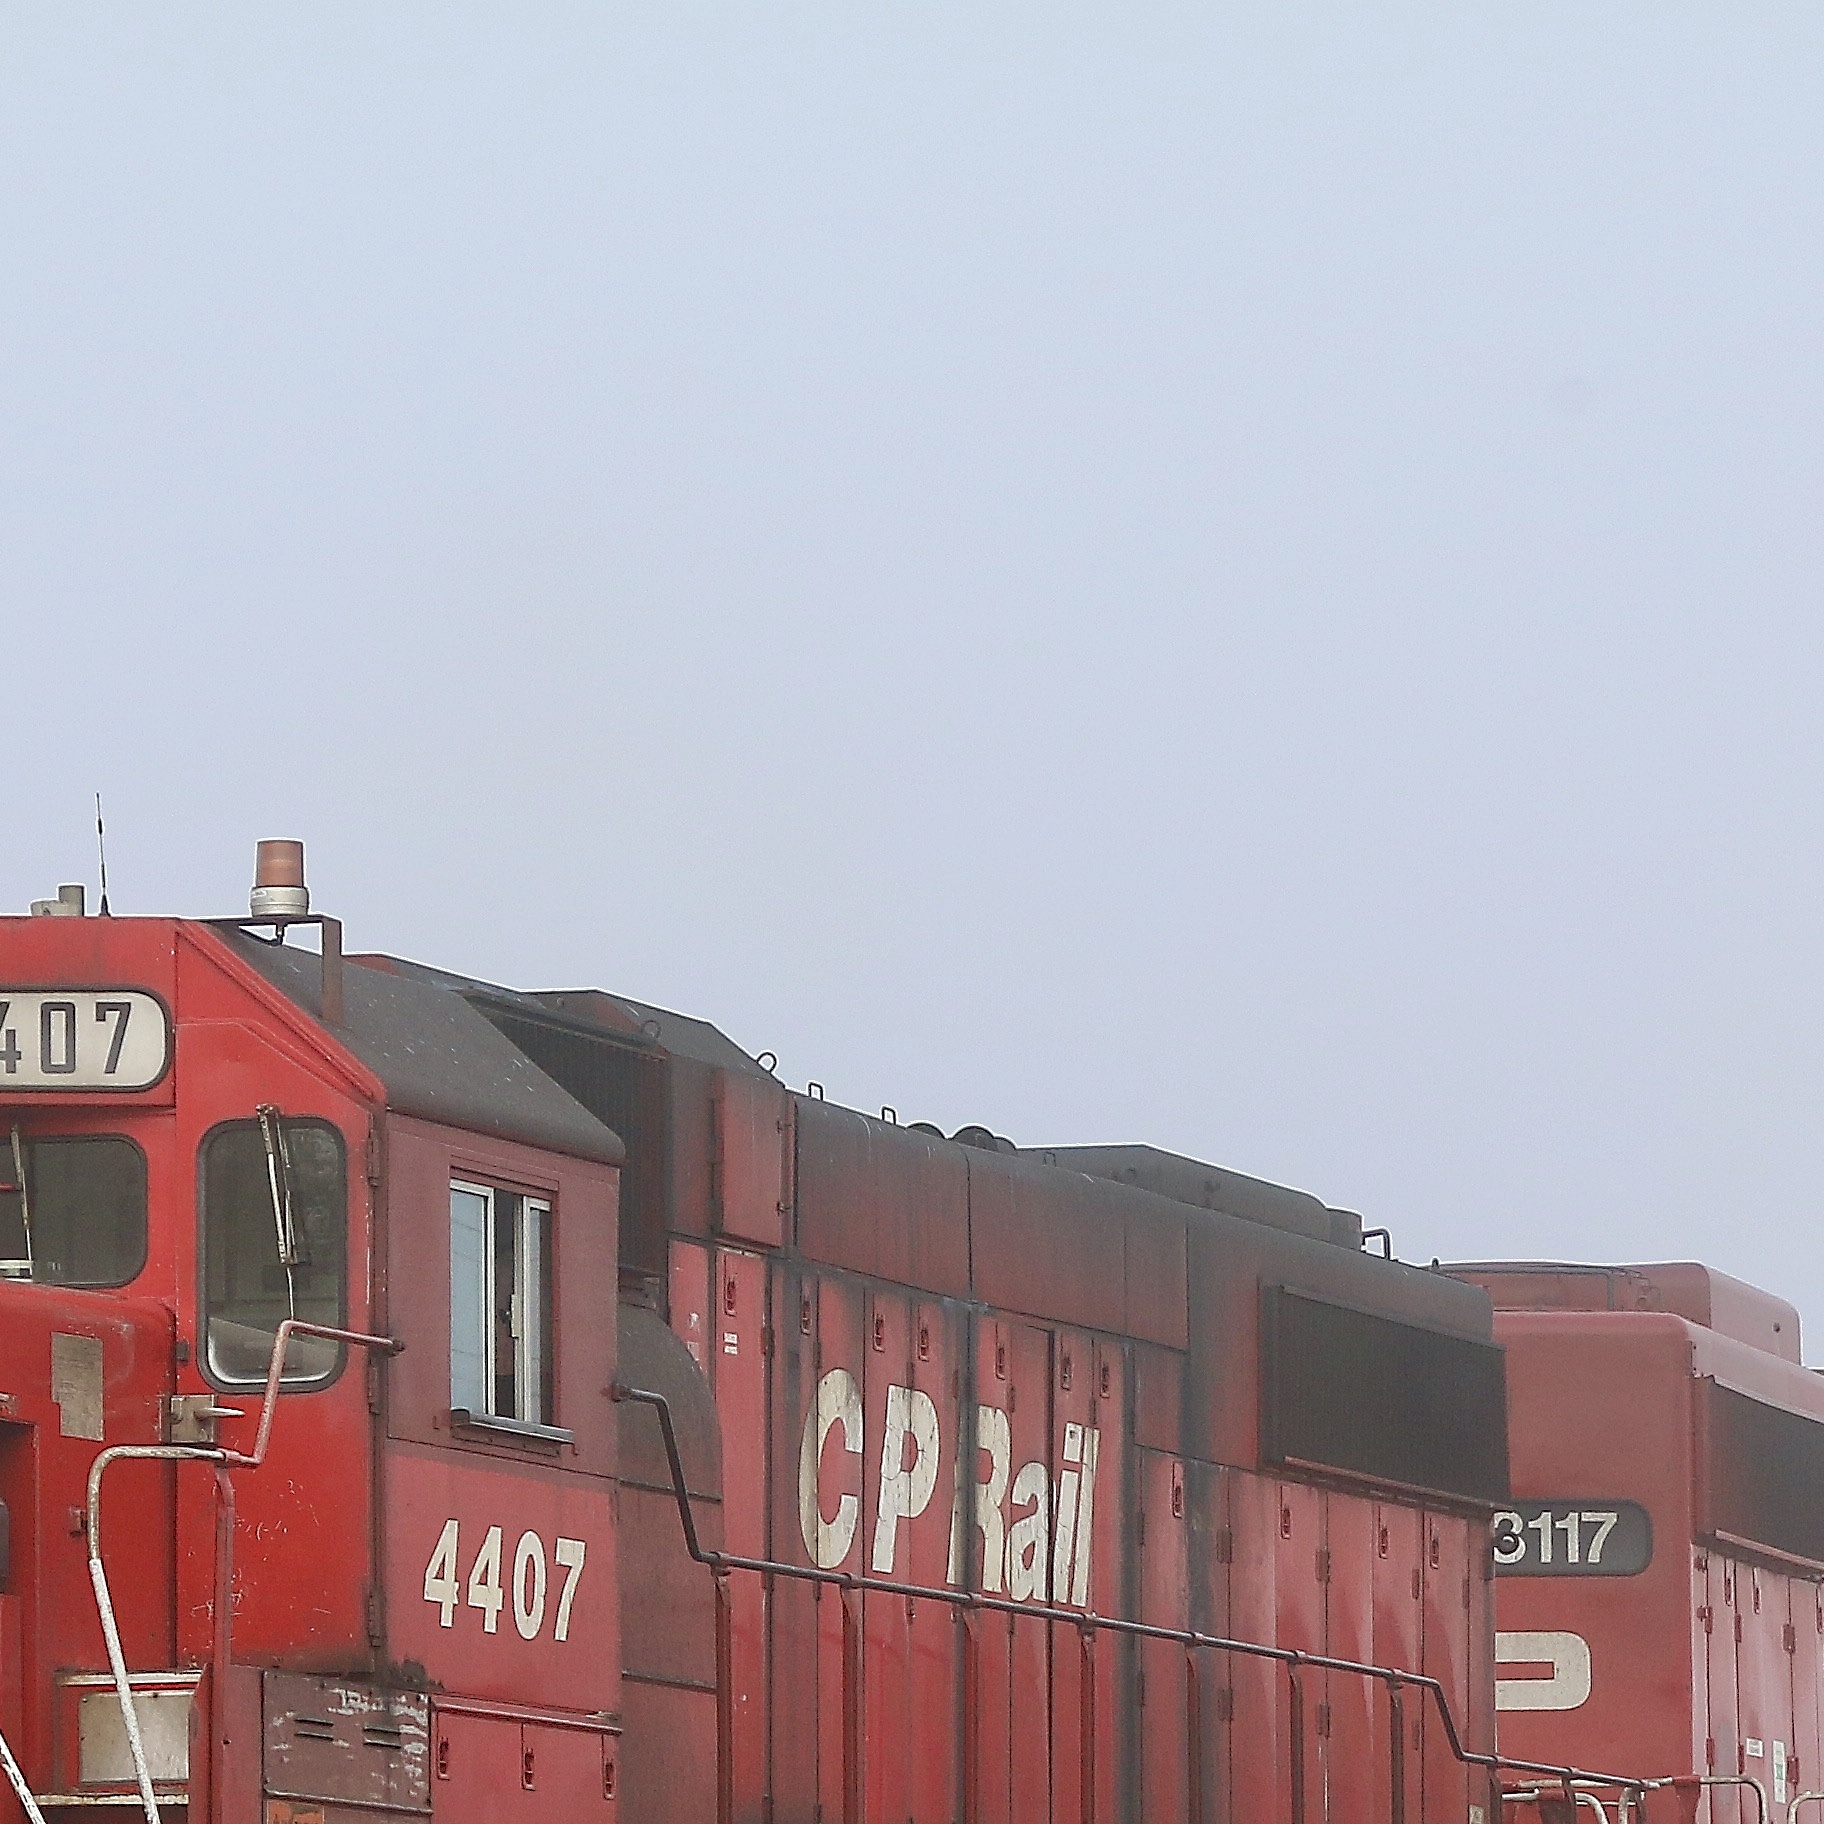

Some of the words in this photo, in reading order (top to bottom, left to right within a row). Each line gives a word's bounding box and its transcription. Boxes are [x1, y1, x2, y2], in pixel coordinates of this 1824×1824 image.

[797, 1366, 941, 1574] CP
[945, 1403, 1101, 1608] Rail
[1493, 1510, 1618, 1564] 3117
[422, 1518, 587, 1642] 4407
